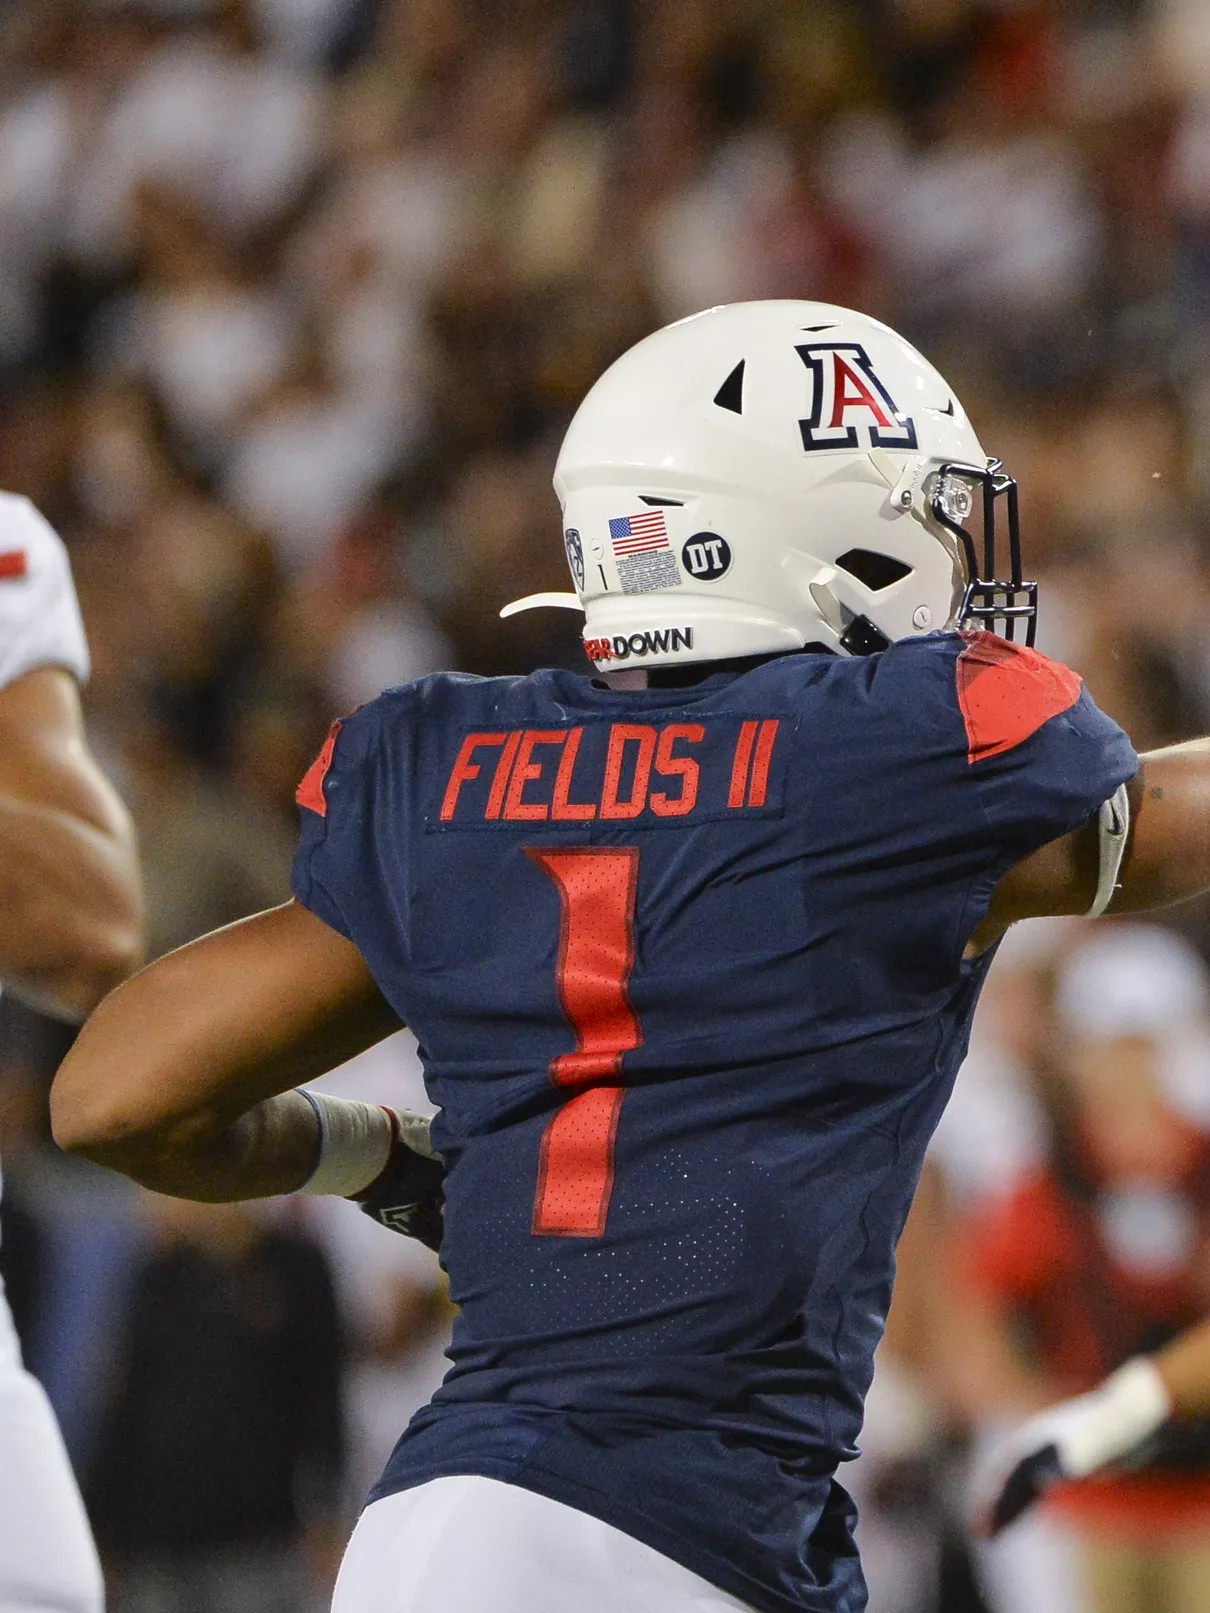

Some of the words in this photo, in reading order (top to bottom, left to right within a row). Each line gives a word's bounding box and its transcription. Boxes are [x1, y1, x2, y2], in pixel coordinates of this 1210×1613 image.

[794, 343, 918, 451] A
[686, 540, 722, 573] DT
[440, 724, 705, 821] FIELDS
[727, 719, 779, 808] II
[522, 846, 644, 1237] 1
